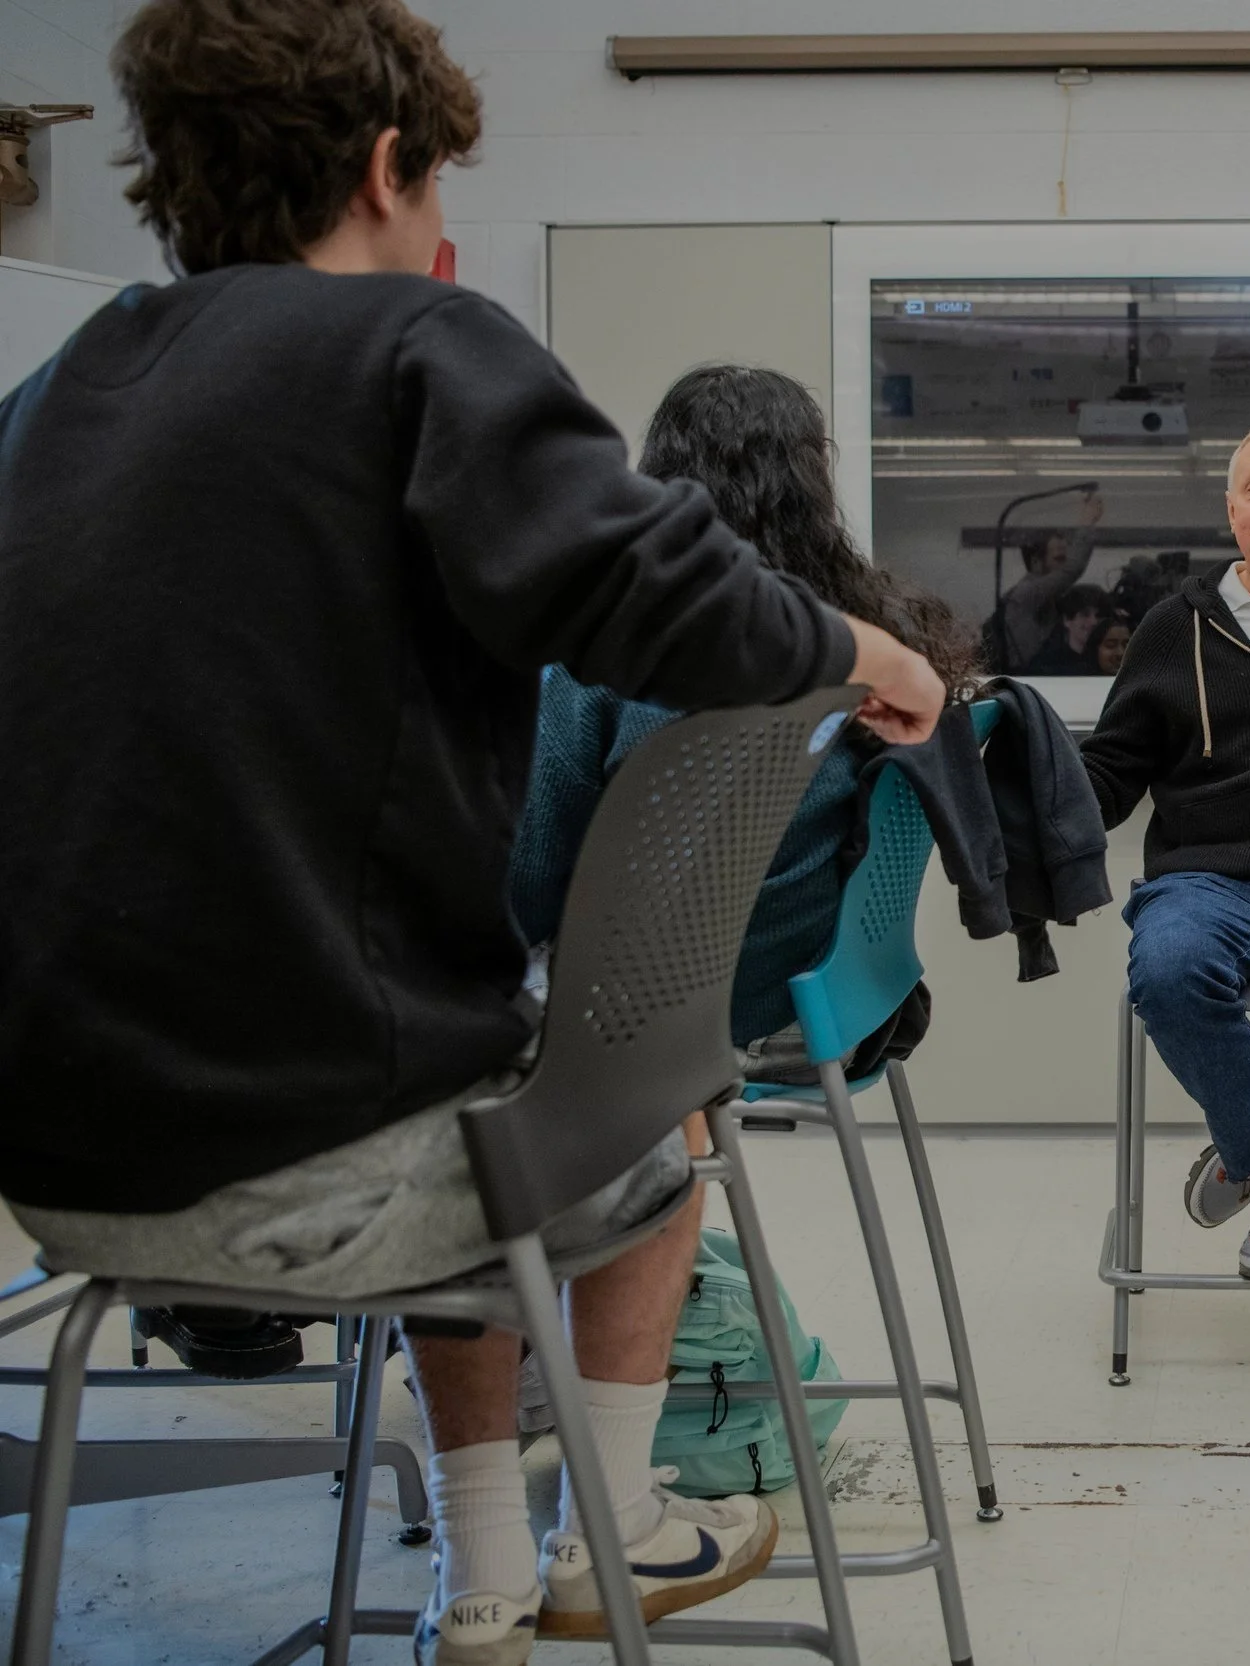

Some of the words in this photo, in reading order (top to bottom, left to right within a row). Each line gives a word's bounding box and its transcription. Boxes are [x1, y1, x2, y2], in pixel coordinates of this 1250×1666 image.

[935, 302, 963, 313] HDMI
[964, 302, 972, 313] 2
[451, 1603, 502, 1627] NIKE
